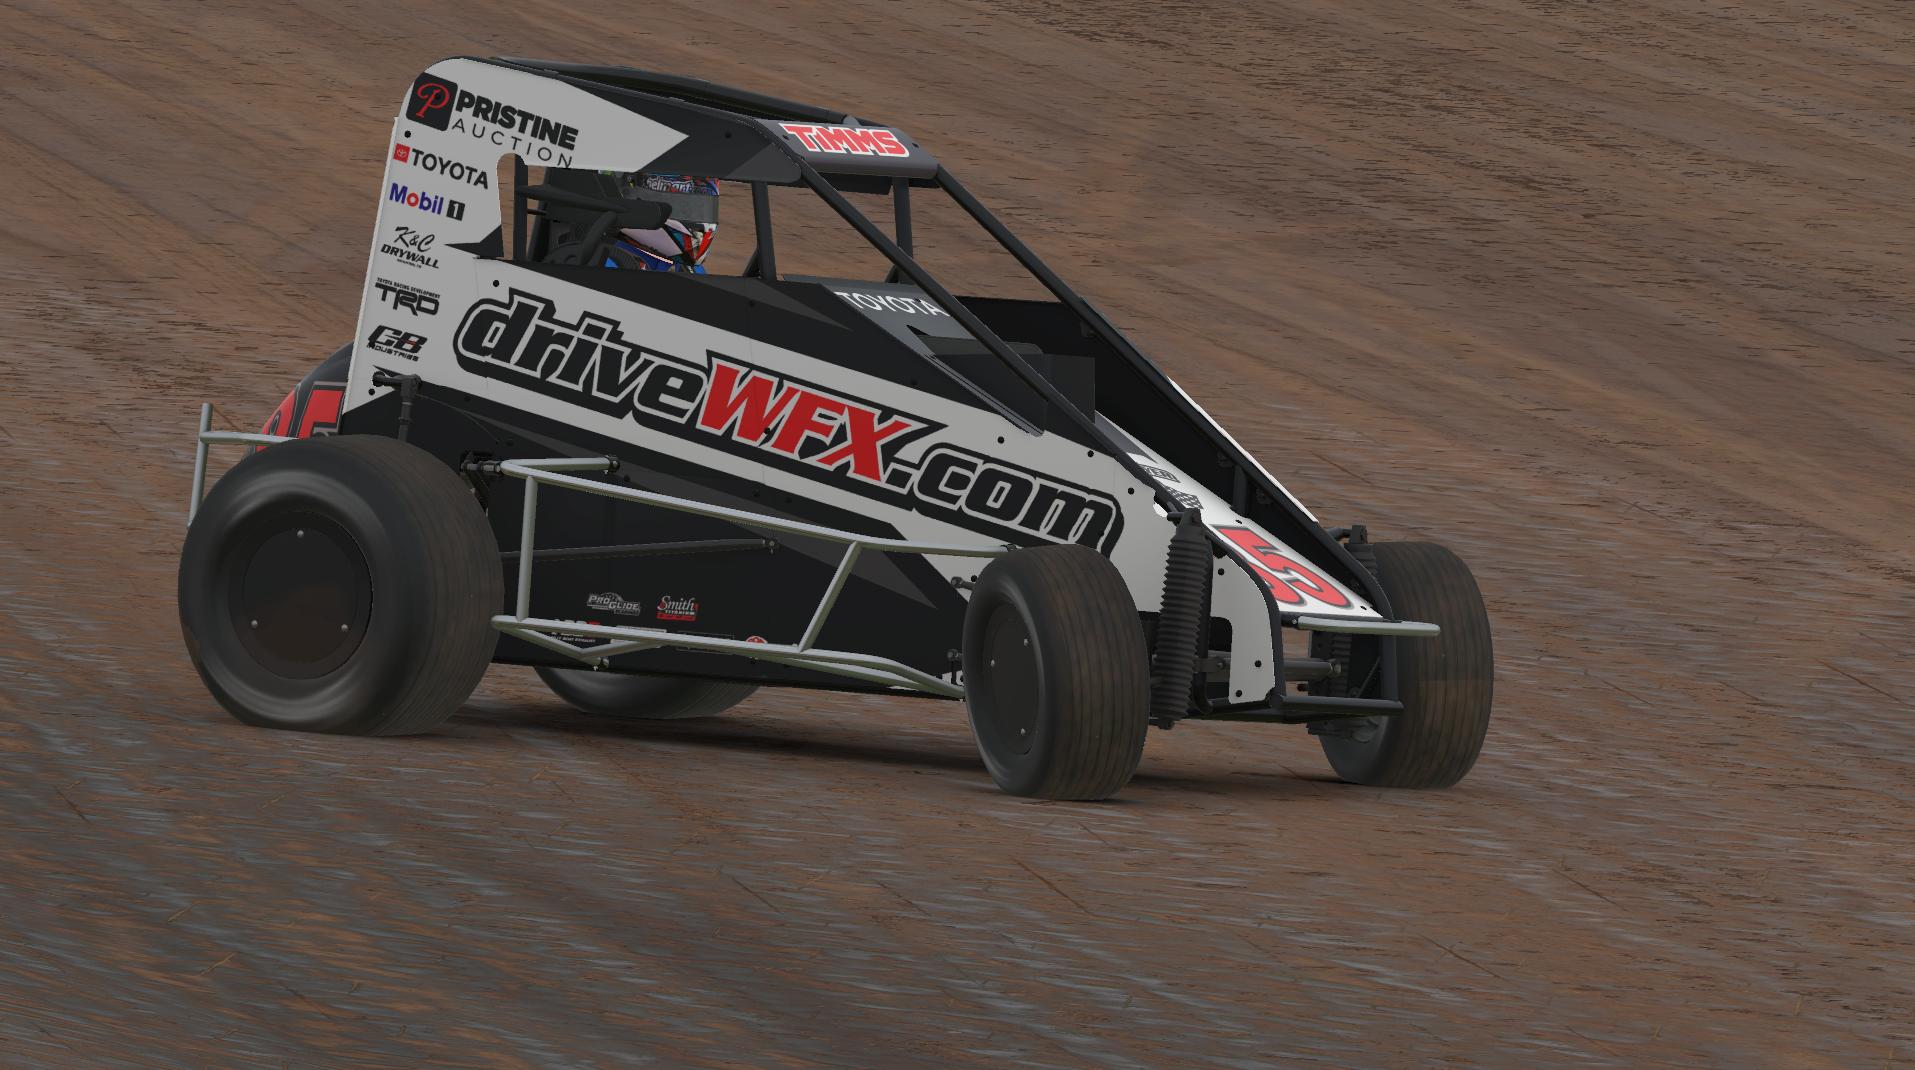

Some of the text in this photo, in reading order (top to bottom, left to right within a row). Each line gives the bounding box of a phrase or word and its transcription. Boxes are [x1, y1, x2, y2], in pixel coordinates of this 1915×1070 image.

[455, 89, 579, 151] PRISTINE
[451, 118, 573, 168] AUCTION
[778, 123, 910, 158] TIMMS
[412, 148, 489, 189] TOYOTA
[389, 183, 463, 219] Mobil 1
[394, 226, 435, 252] K&C
[381, 244, 439, 269] DRYWALL
[375, 282, 440, 316] TRD
[833, 291, 951, 317] TOYOTA
[657, 595, 696, 612] Smith
